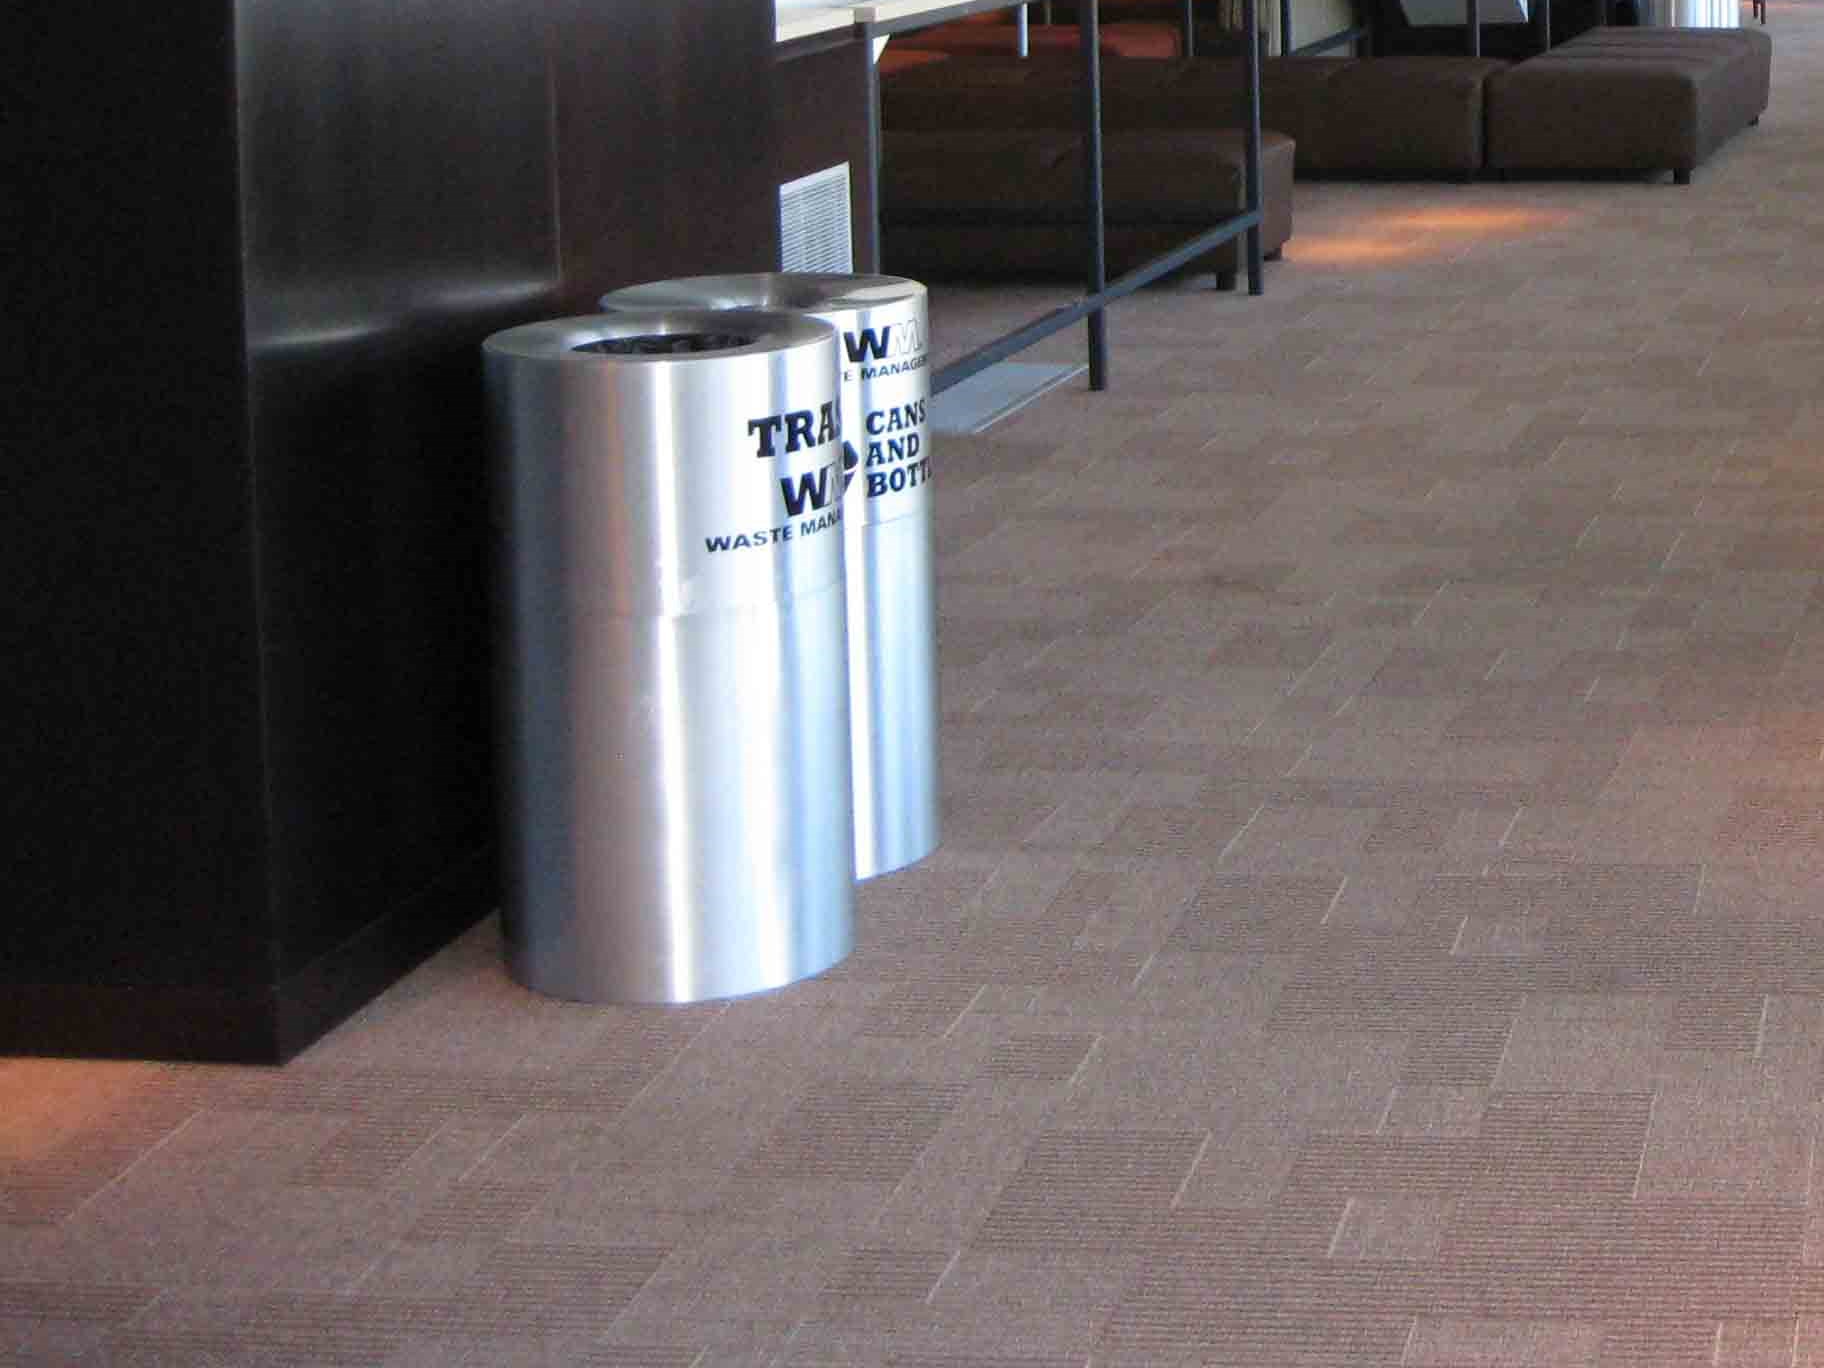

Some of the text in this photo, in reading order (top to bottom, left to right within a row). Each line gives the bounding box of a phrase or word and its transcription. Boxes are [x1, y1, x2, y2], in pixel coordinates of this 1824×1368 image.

[748, 399, 842, 459] TRA
[866, 399, 927, 436] CANS
[866, 433, 920, 468] AND
[705, 525, 793, 553] WASTE
